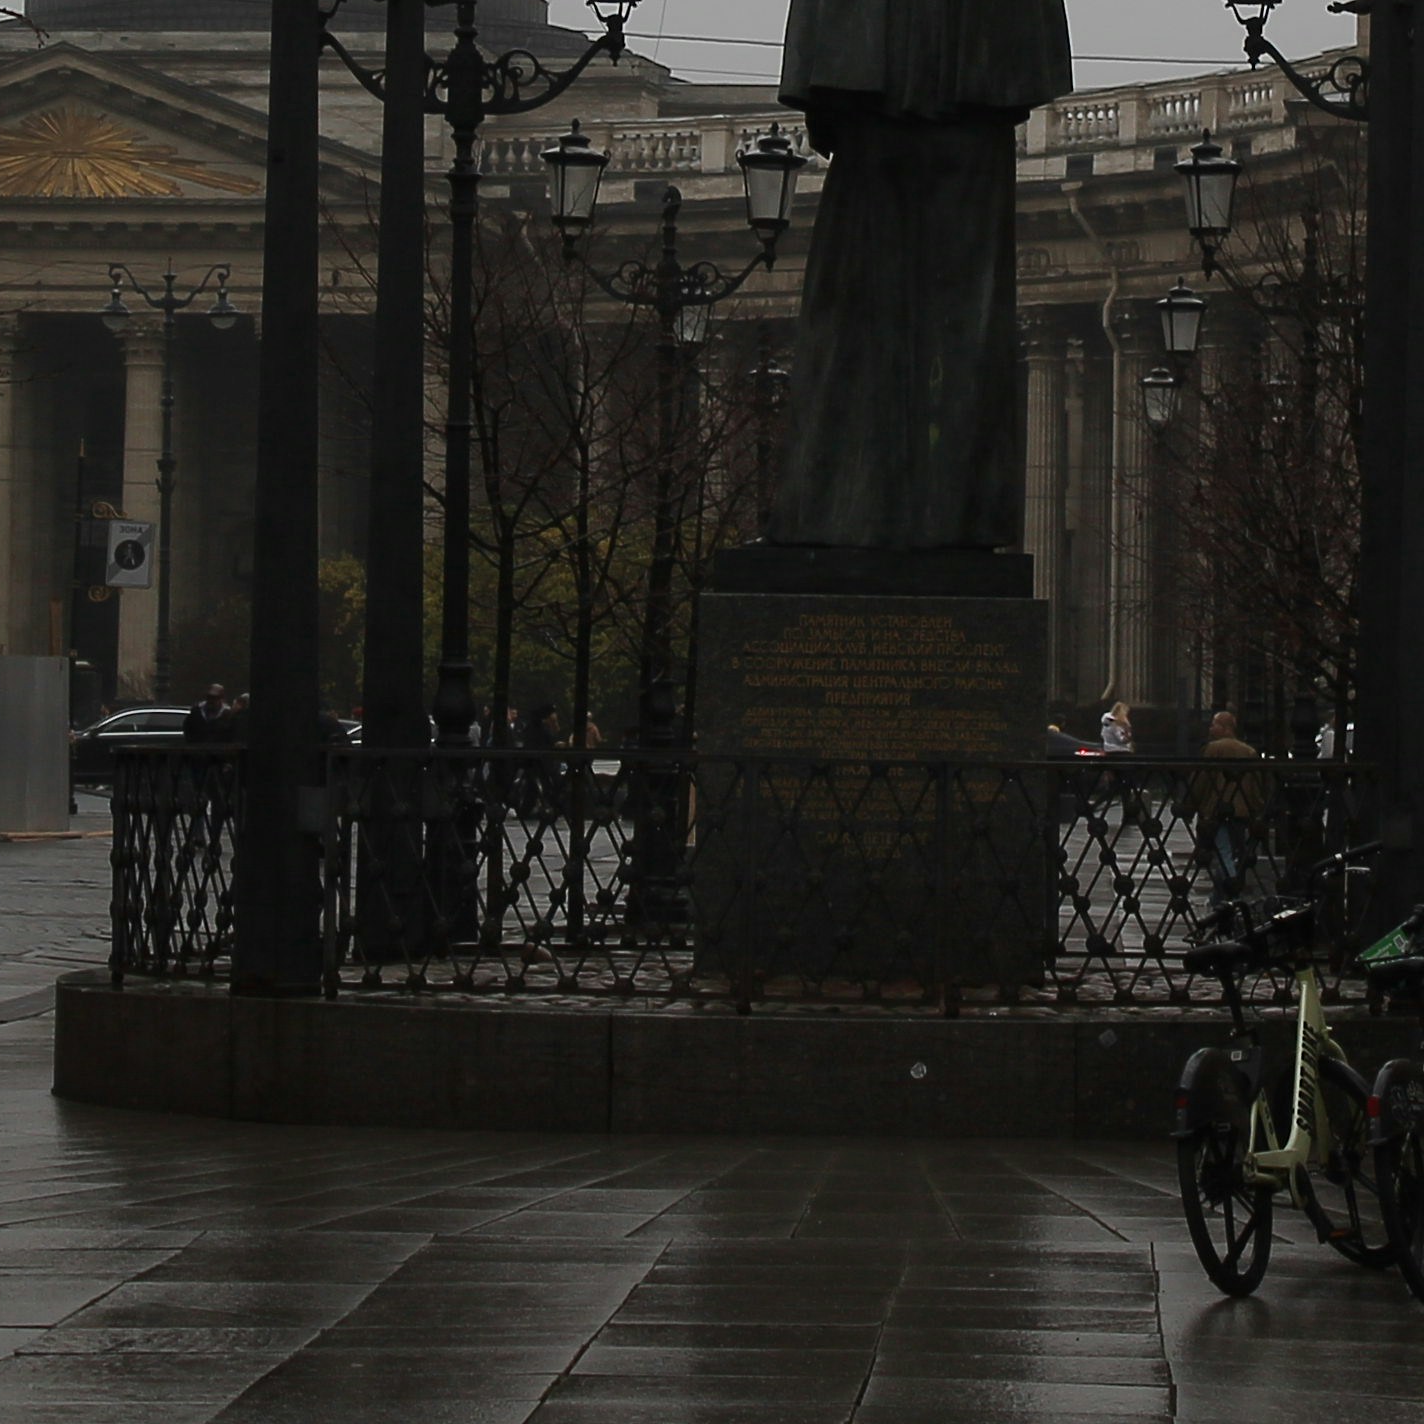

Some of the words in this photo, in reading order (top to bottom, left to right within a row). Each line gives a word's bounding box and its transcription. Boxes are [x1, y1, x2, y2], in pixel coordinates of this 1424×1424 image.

[120, 525, 143, 533] ЗОНА
[799, 614, 865, 627] ПАМЯТНИК
[871, 615, 953, 628] УСТАНОВЛЕН
[784, 628, 802, 640] ПО
[884, 630, 901, 642] НА
[906, 630, 966, 643] СРЕДСТВА
[834, 642, 867, 655] КЛУБ
[743, 657, 837, 671] СООРУЖЕНИЕ
[840, 658, 916, 672] ПАМЯТНИКА
[921, 659, 970, 673] ВНЕСЛИ
[743, 675, 848, 688] АДМИНИСТРАЦИЯ
[853, 676, 951, 689] ЦЕНТРАЛЬНОГО
[825, 691, 911, 705] ПРЕДПРИЯТИЯ
[1297, 1066, 1316, 1138] SMART
